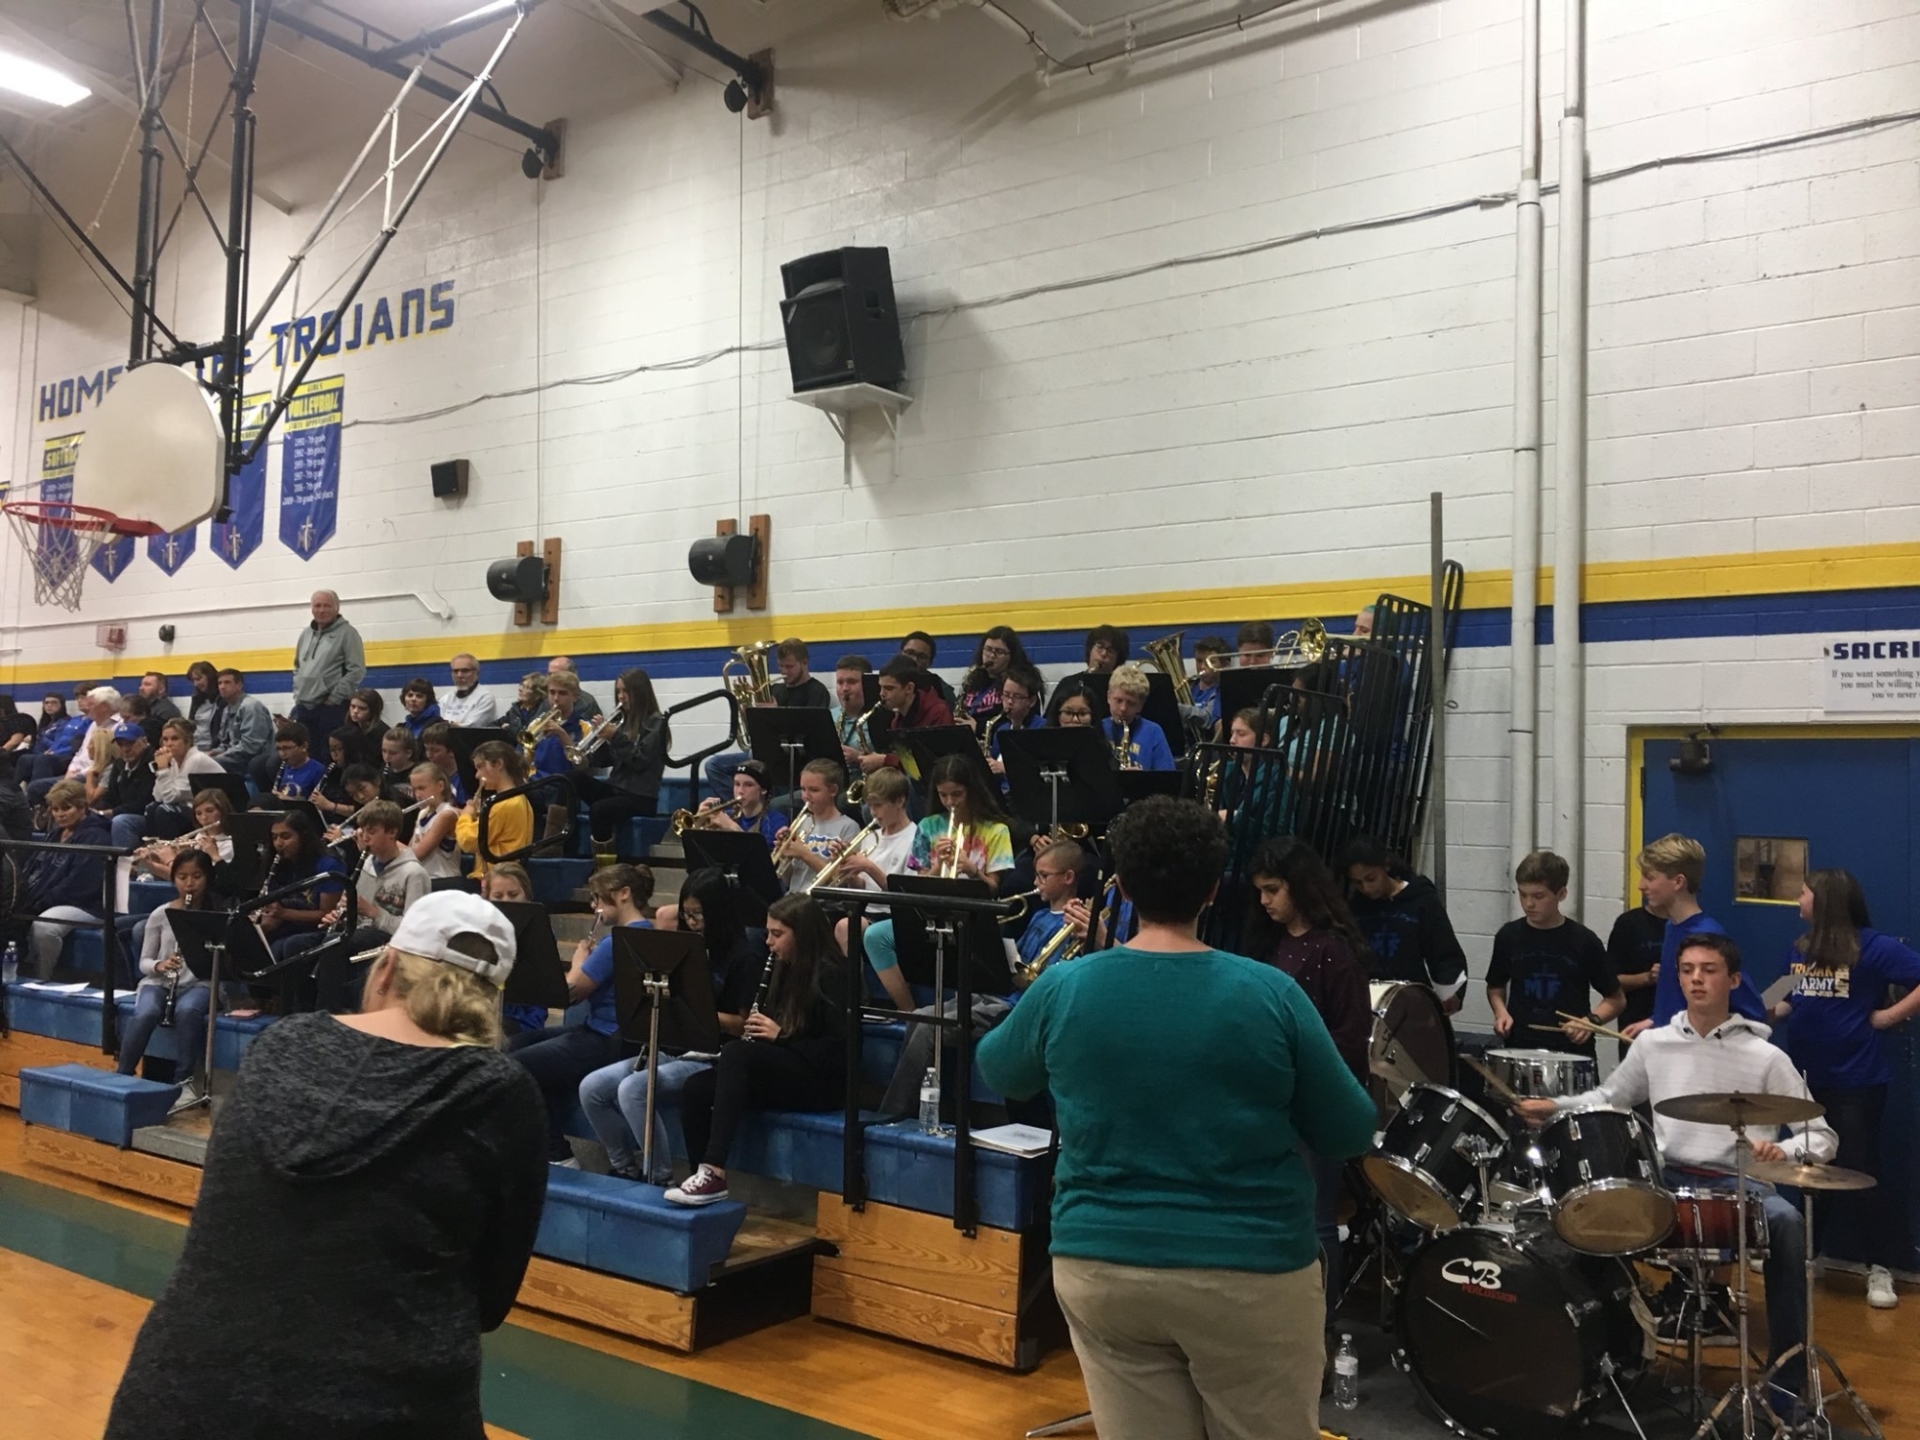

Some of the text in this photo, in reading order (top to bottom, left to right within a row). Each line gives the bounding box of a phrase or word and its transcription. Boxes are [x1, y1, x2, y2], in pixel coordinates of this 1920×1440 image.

[39, 365, 123, 422] HOME
[270, 279, 455, 368] TROJANS
[1833, 641, 1920, 660] SACRI
[1840, 670, 1853, 680] you
[1856, 669, 1873, 678] want
[1876, 668, 1914, 679] something
[1840, 681, 1853, 690] you
[1856, 680, 1873, 689] must
[1876, 679, 1885, 688] be
[1888, 678, 1912, 690] willing
[1897, 691, 1917, 699] never
[1801, 977, 1834, 990] ARMY
[1441, 1257, 1502, 1290] CB
